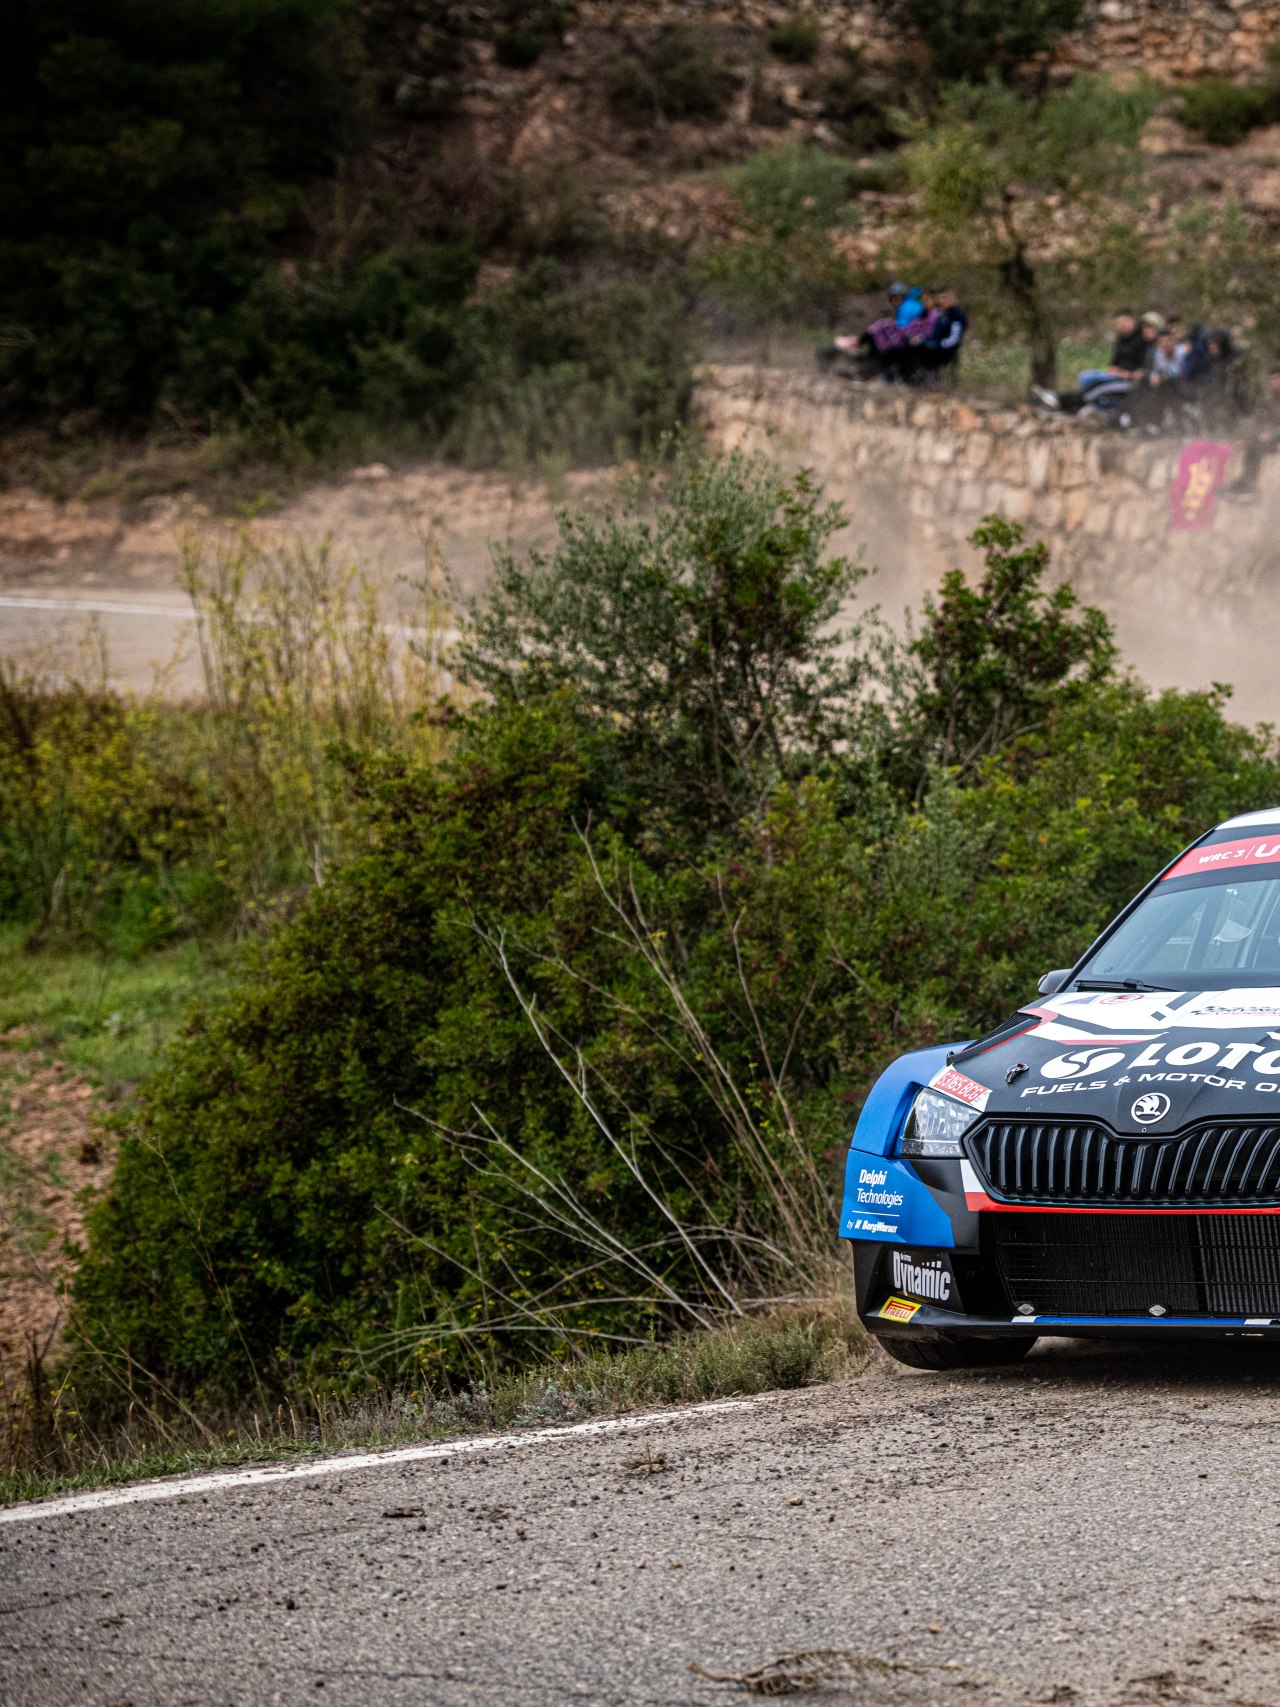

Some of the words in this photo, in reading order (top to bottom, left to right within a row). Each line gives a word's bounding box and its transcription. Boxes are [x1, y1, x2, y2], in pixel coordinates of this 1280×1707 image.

[1199, 850, 1232, 864] WRC
[1233, 849, 1246, 858] 3
[957, 1082, 985, 1100] BCG
[1020, 1080, 1108, 1098] FUELS
[1113, 1075, 1131, 1087] &
[1138, 1073, 1246, 1090] MOTOR
[859, 1169, 887, 1188] Delphi
[857, 1188, 903, 1208] Technologies
[847, 1220, 854, 1229] by
[862, 1220, 898, 1233] BorgWarner
[893, 1250, 951, 1301] Dynamic
[883, 1300, 917, 1319] PIRELLI
